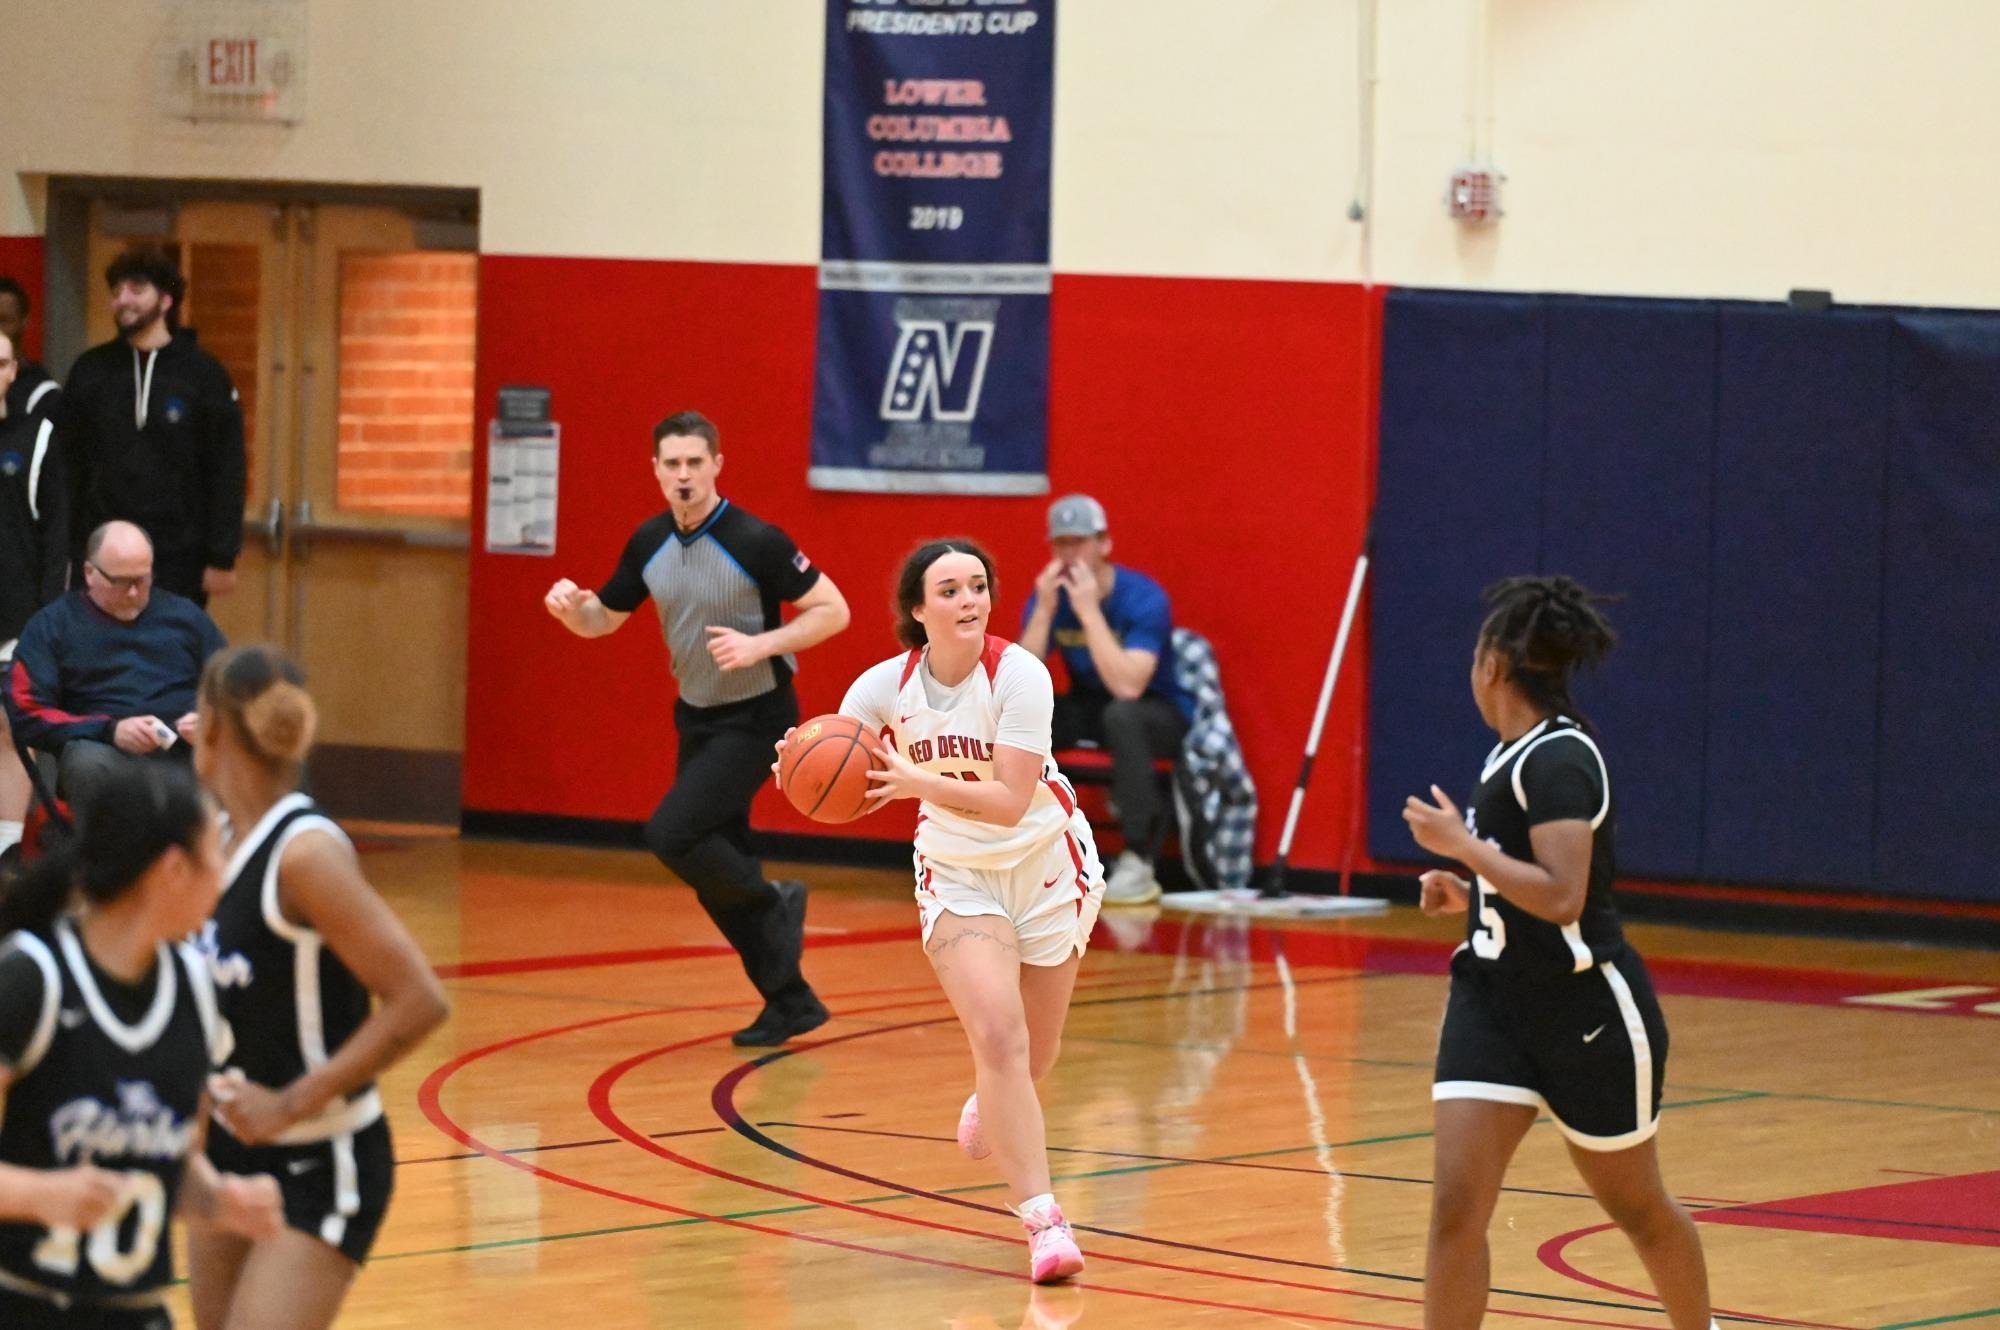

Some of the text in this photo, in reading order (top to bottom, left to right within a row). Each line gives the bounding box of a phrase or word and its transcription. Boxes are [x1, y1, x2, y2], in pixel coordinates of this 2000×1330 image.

[847, 10, 1039, 35] PRESIDENTS CUP
[208, 38, 258, 86] EXIT
[884, 78, 987, 107] LOWER
[866, 114, 1012, 143] COLUMBIA
[873, 150, 1003, 179] COLLEGE
[909, 205, 964, 231] 2019
[880, 320, 995, 422] N
[908, 734, 994, 765] RED DEVILS
[1471, 874, 1507, 961] 5
